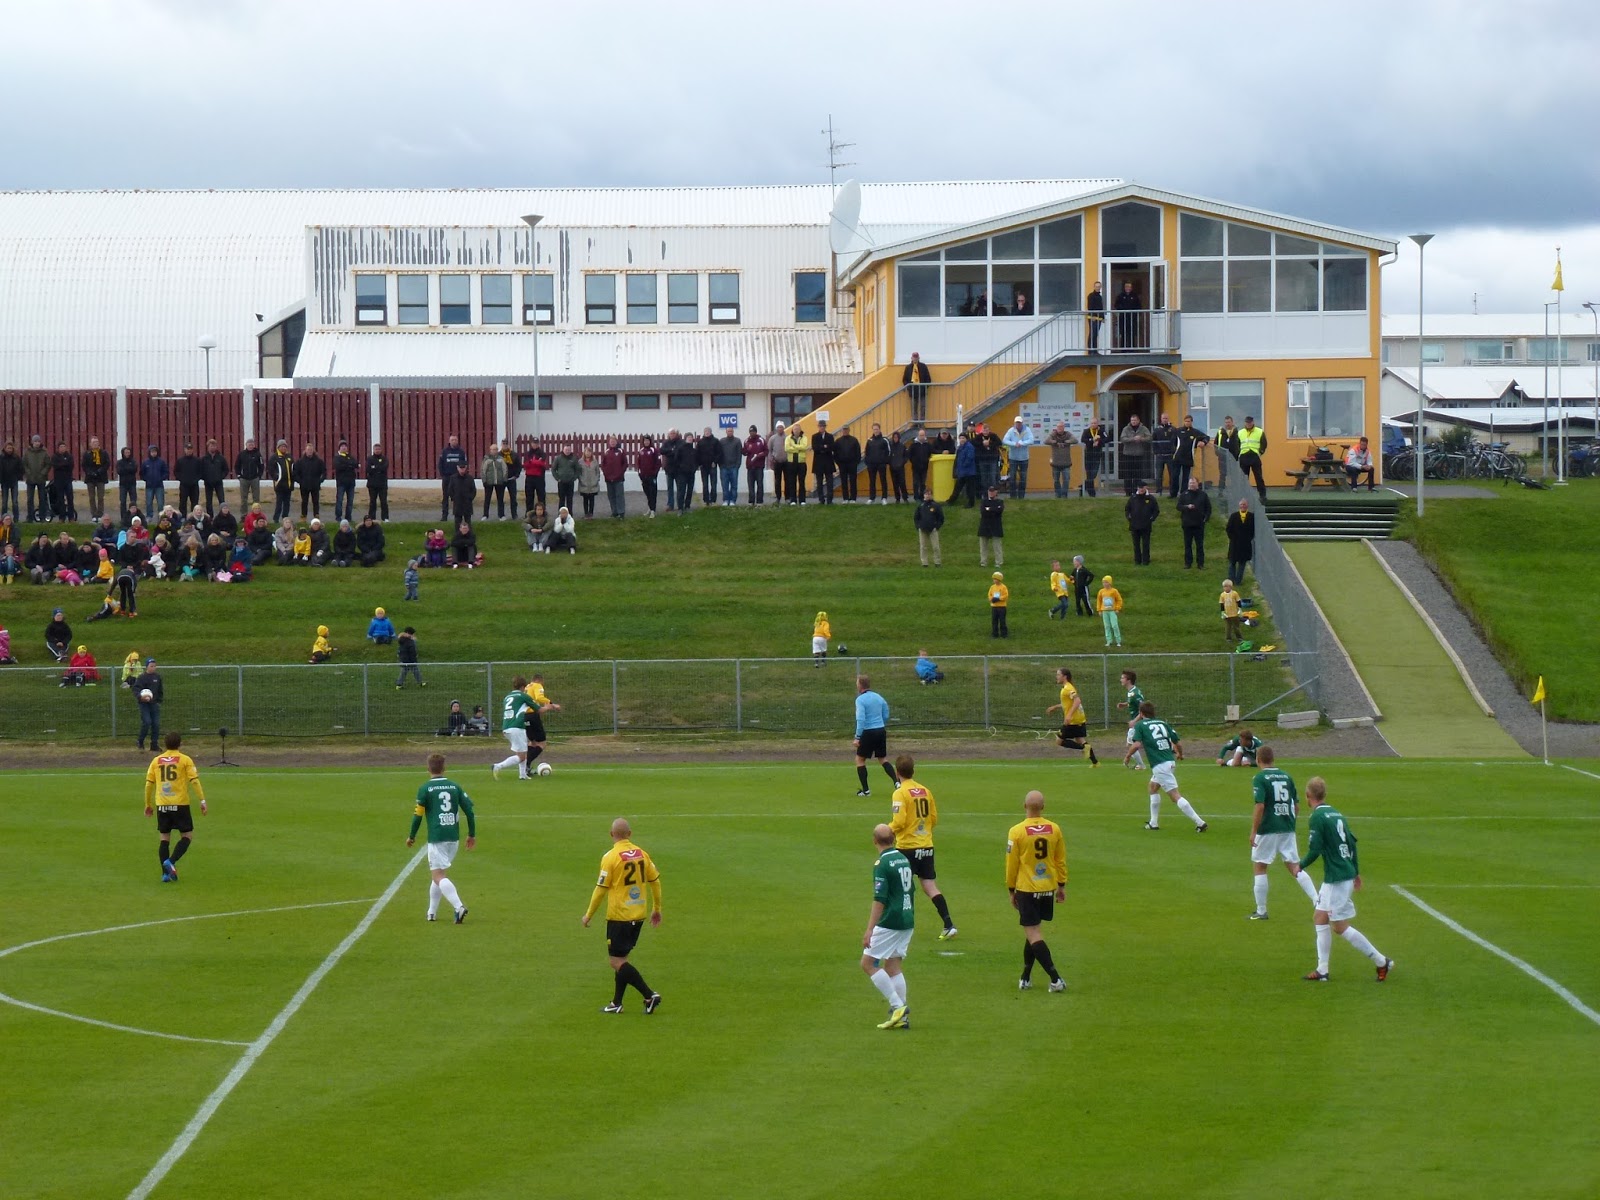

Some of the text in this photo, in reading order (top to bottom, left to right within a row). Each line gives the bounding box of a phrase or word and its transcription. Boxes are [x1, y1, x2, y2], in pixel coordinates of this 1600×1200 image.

[720, 416, 737, 425] WC
[505, 696, 514, 710] 2
[1149, 724, 1168, 739] 21
[158, 764, 178, 782] 16
[438, 791, 452, 812] 3
[1271, 781, 1290, 802] 15
[913, 797, 930, 818] 10
[1034, 837, 1048, 860] 9
[623, 859, 646, 886] 21
[898, 866, 912, 892] 19
